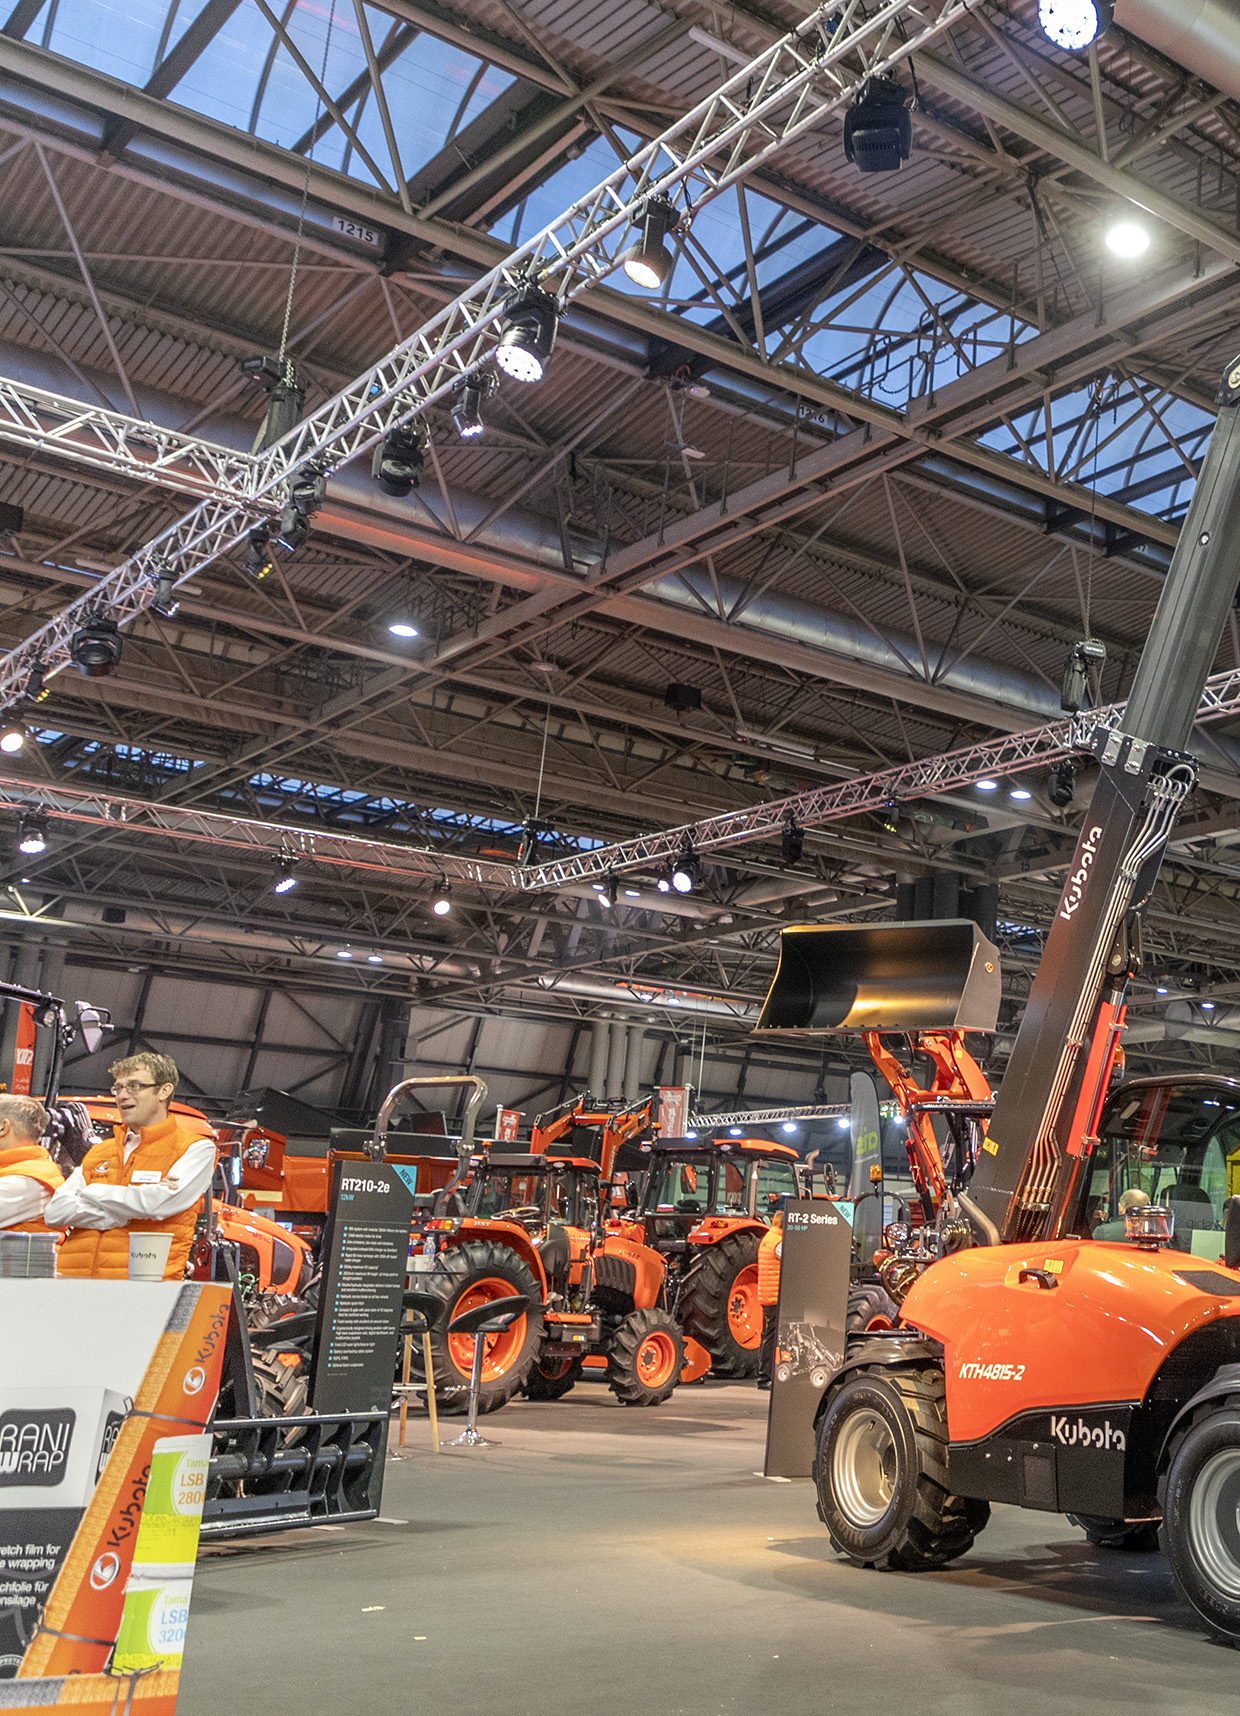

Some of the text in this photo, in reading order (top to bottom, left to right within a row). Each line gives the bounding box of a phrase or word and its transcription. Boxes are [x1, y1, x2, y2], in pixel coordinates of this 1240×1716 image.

[338, 220, 374, 242] 1215
[800, 406, 825, 423] 126
[1059, 825, 1103, 921] Kubota
[399, 1169, 414, 1186] NEW
[341, 1178, 390, 1194] RT210-2e
[788, 1212, 838, 1226] RT-2 Series
[839, 1205, 851, 1219] NEW
[130, 1251, 157, 1260] Kubota
[194, 1304, 230, 1364] Kubota
[958, 1362, 1026, 1381] KTH4815-2
[0, 1422, 70, 1452] RANI
[1050, 1415, 1126, 1452] Kubota
[180, 1472, 204, 1487] LSB
[107, 1464, 151, 1547] Kubota
[0, 1543, 61, 1556] etch film for
[7, 1557, 56, 1570] wrapping
[0, 1580, 49, 1593] chfolie für
[161, 1609, 188, 1625] LSB
